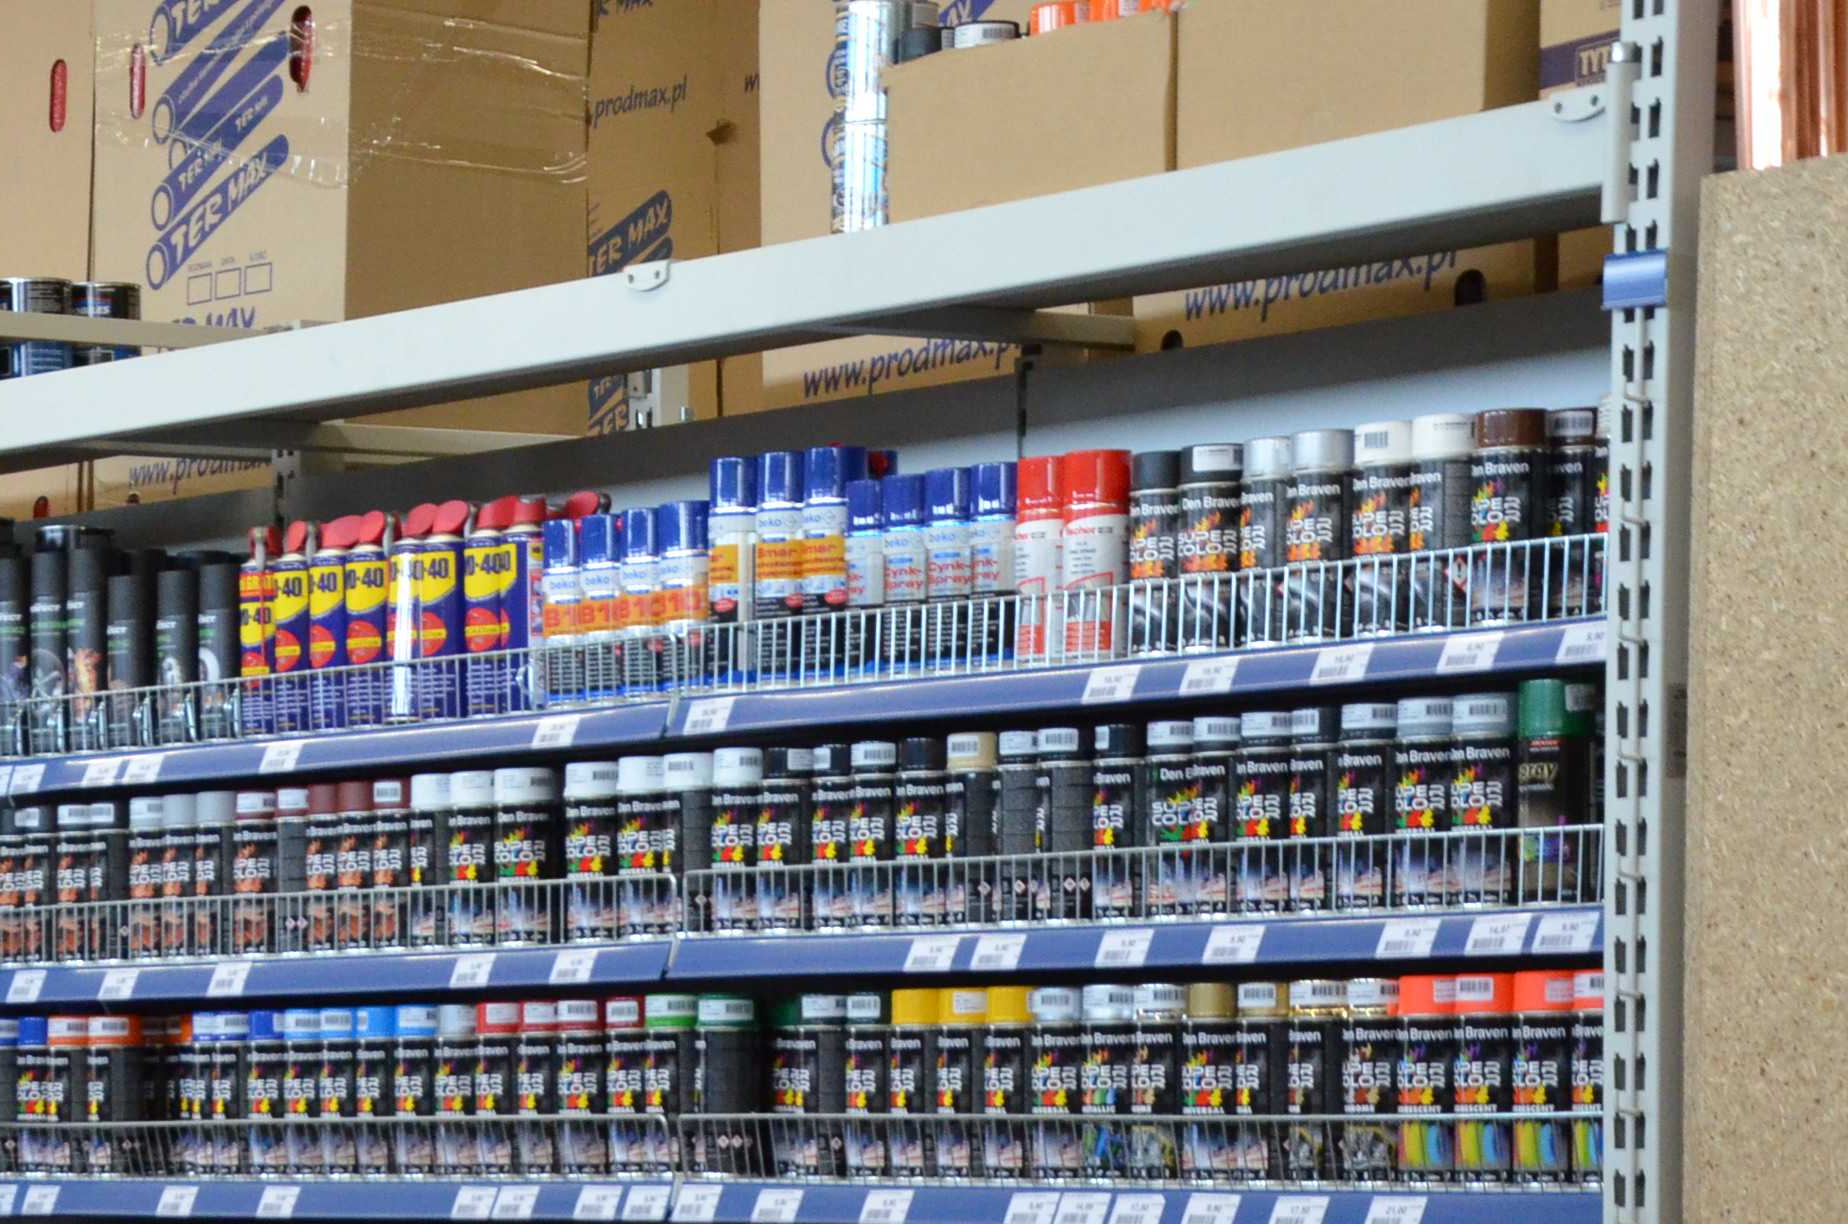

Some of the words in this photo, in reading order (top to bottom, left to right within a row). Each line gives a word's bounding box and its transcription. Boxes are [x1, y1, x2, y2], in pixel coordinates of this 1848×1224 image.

[170, 200, 223, 264] TER
[227, 152, 268, 213] MAX
[627, 197, 670, 252] MAX
